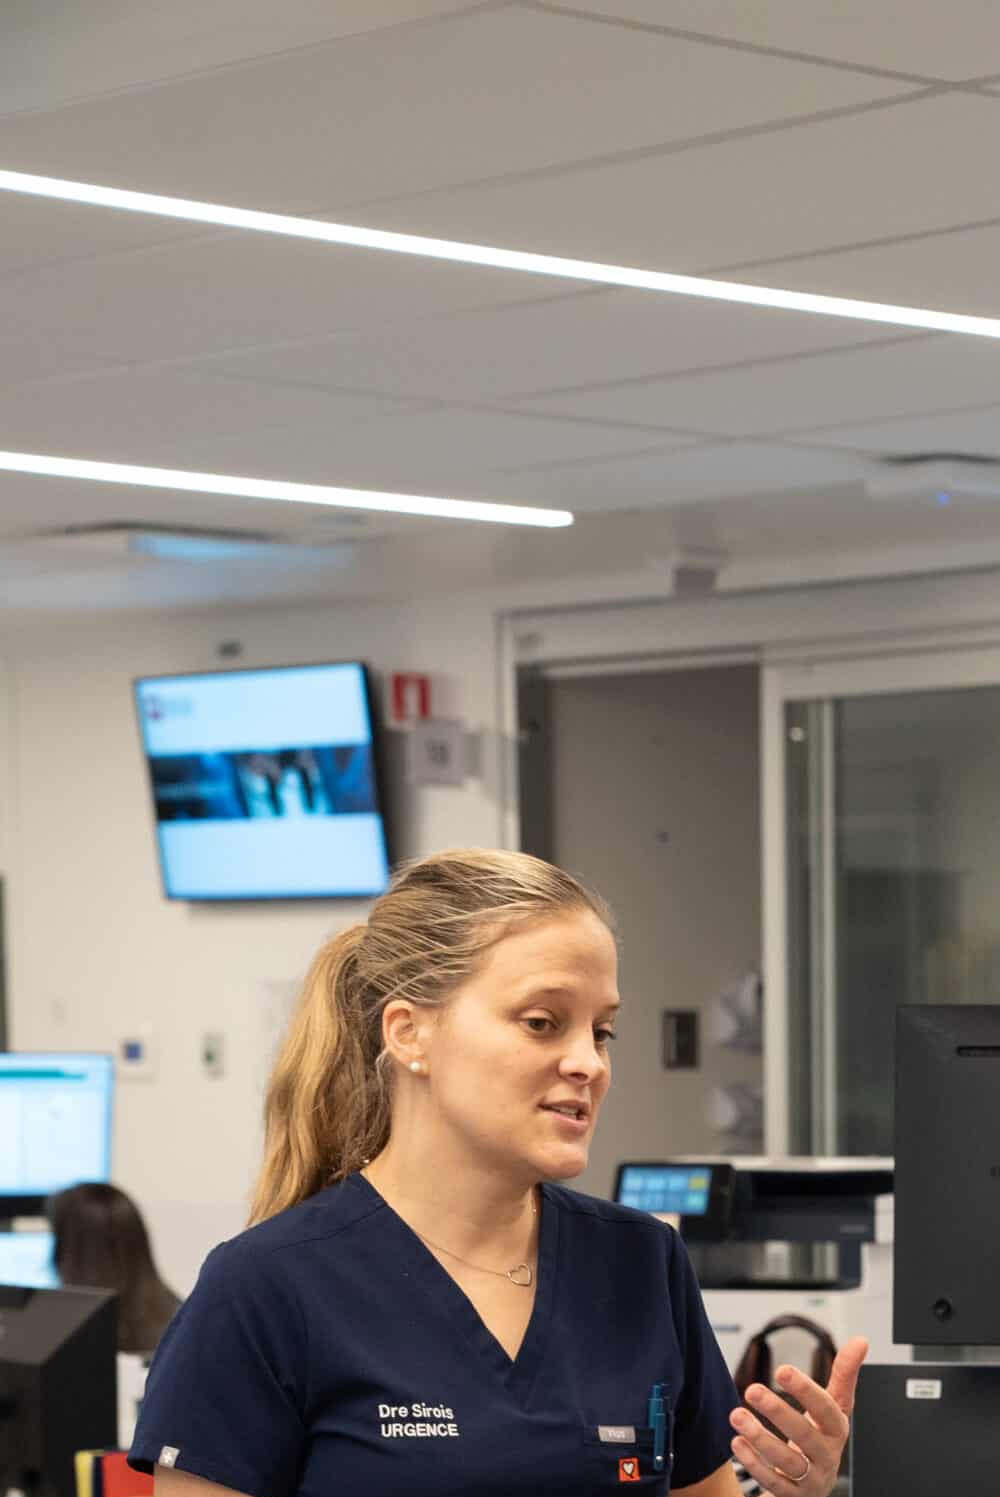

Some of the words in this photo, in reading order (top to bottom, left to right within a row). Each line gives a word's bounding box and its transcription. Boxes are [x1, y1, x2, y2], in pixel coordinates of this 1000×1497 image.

[378, 1403, 409, 1418] Dre
[411, 1402, 455, 1420] Sirois
[381, 1423, 460, 1438] URGENCE
